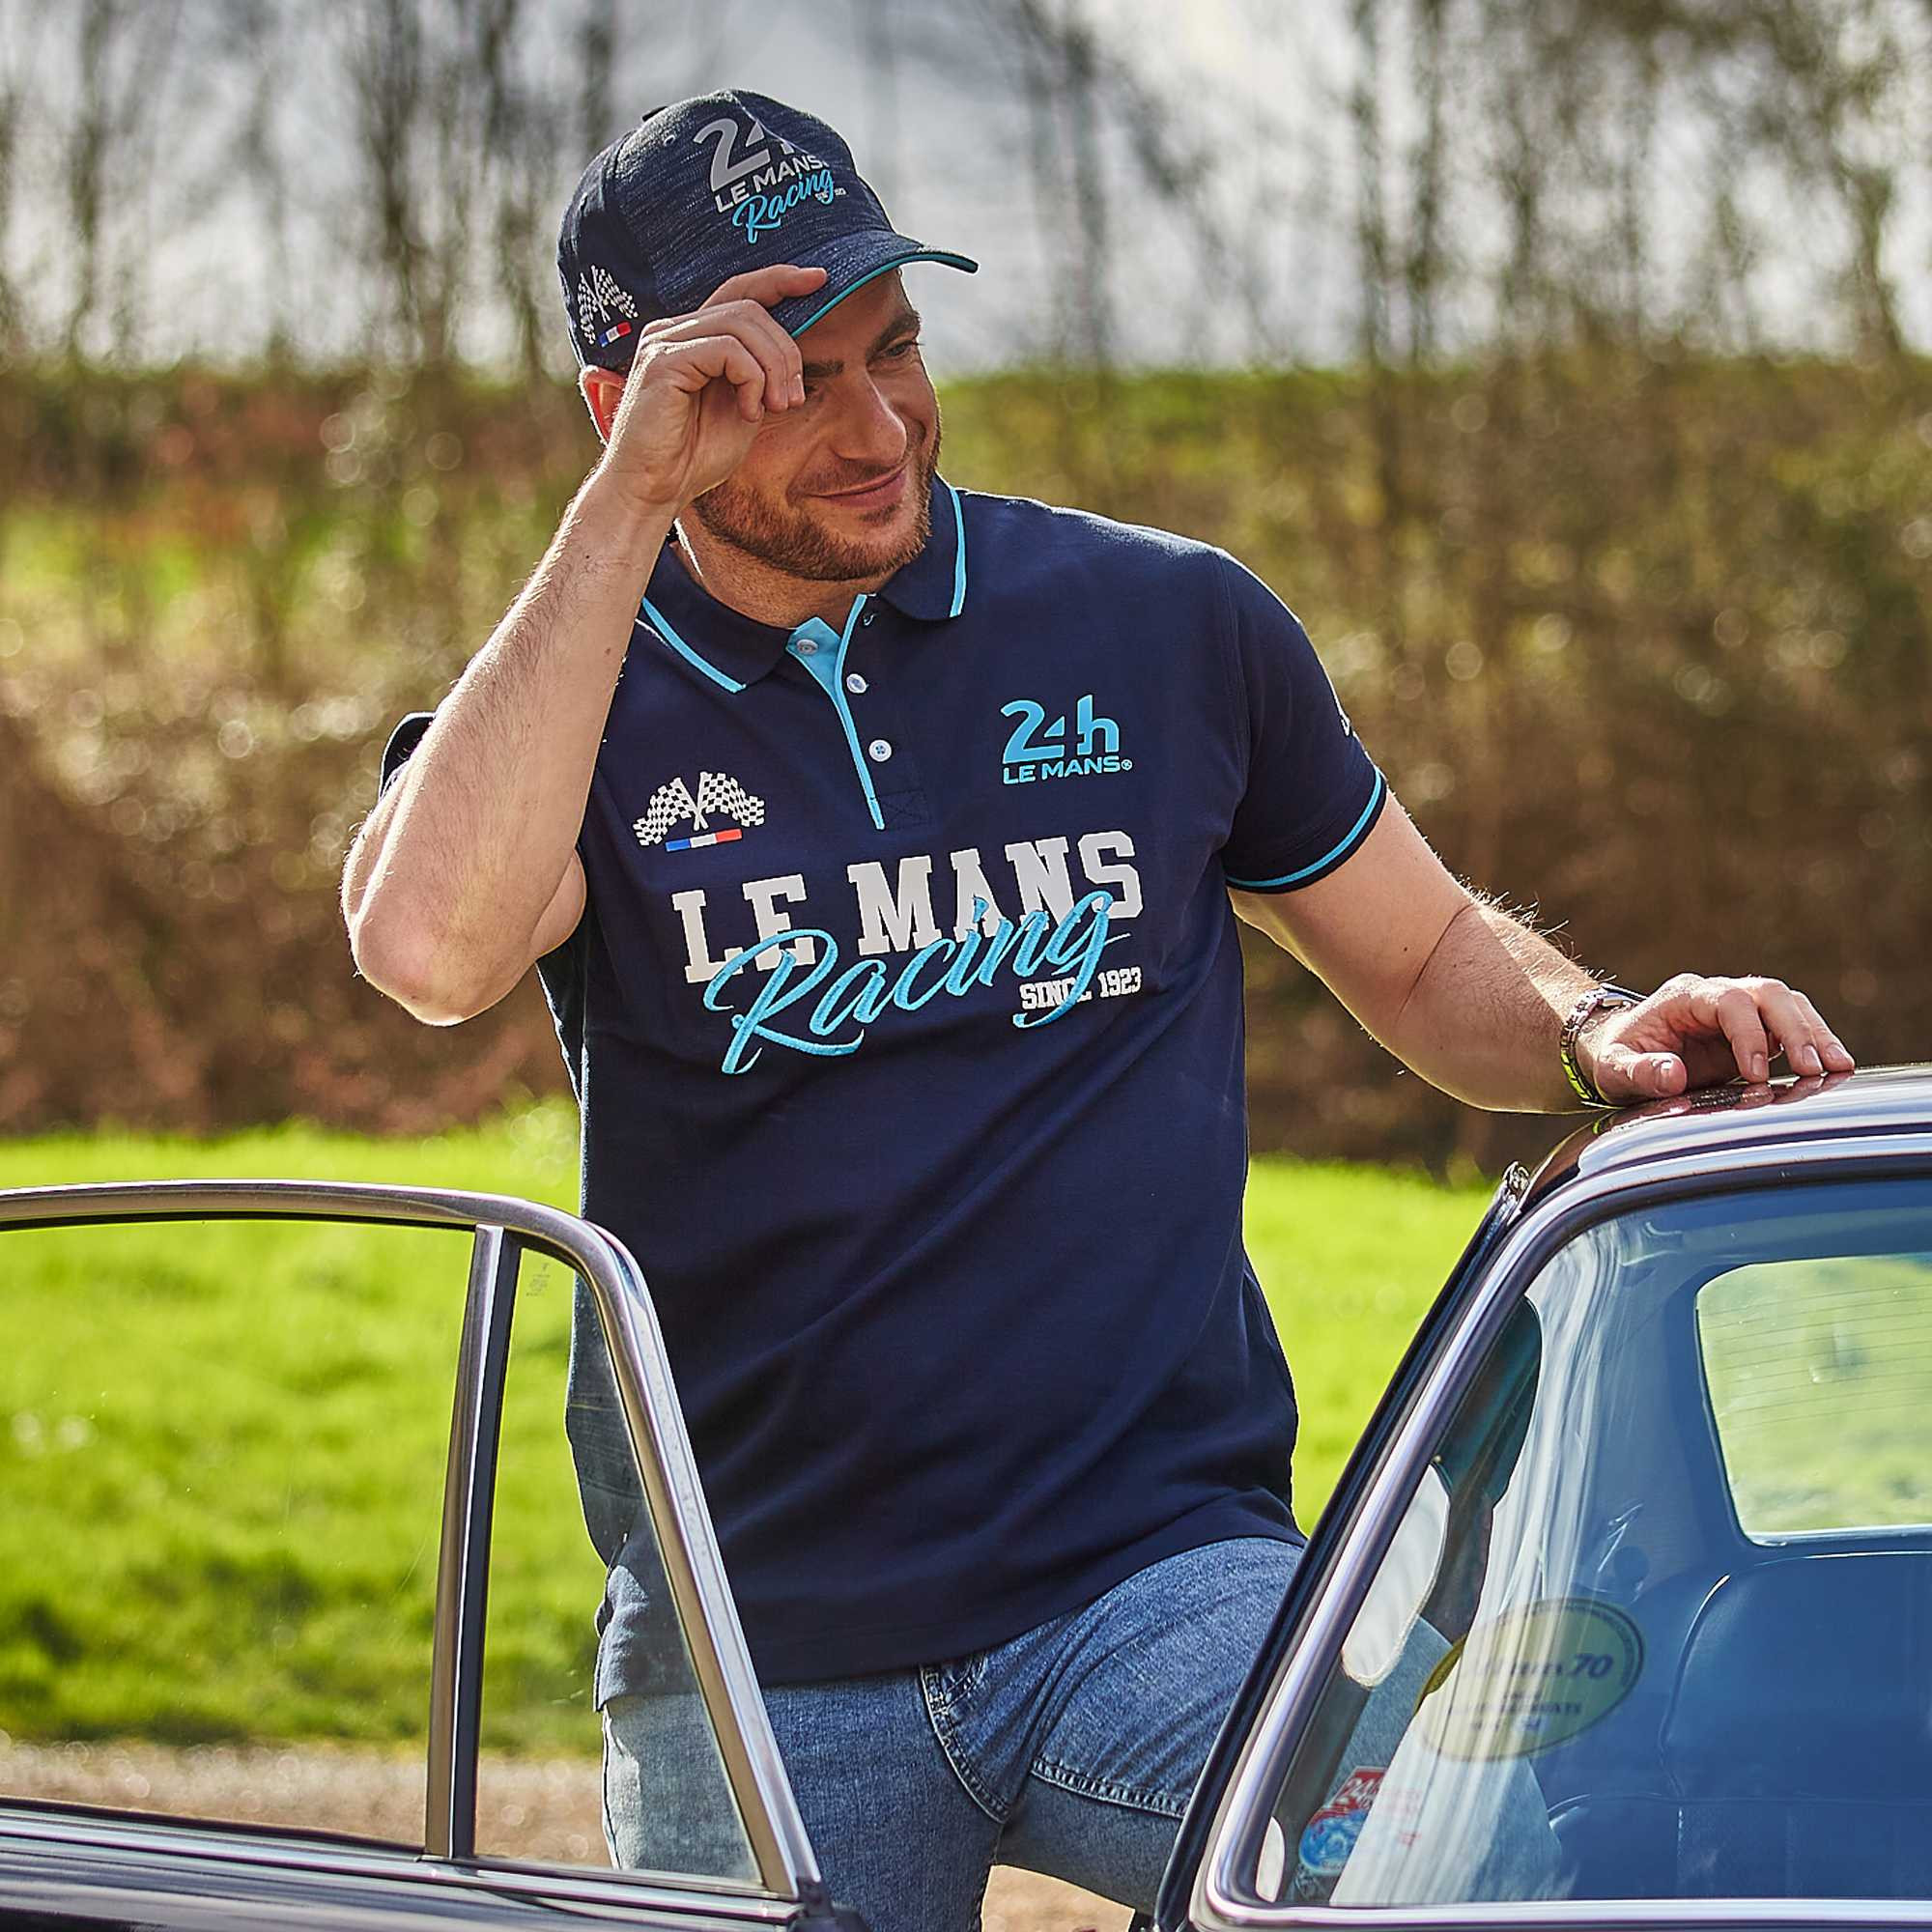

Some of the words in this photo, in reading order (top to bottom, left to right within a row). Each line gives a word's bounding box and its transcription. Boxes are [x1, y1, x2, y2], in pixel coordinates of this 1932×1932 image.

[715, 181, 750, 213] LE
[732, 169, 834, 243] Racing
[1000, 694, 1120, 764] 24h
[1003, 764, 1037, 785] LE
[672, 873, 816, 983] LE
[846, 830, 1144, 955] MANS
[702, 890, 1132, 1074] Racing
[1019, 977, 1093, 1010] SINC
[1097, 966, 1142, 998] 1923
